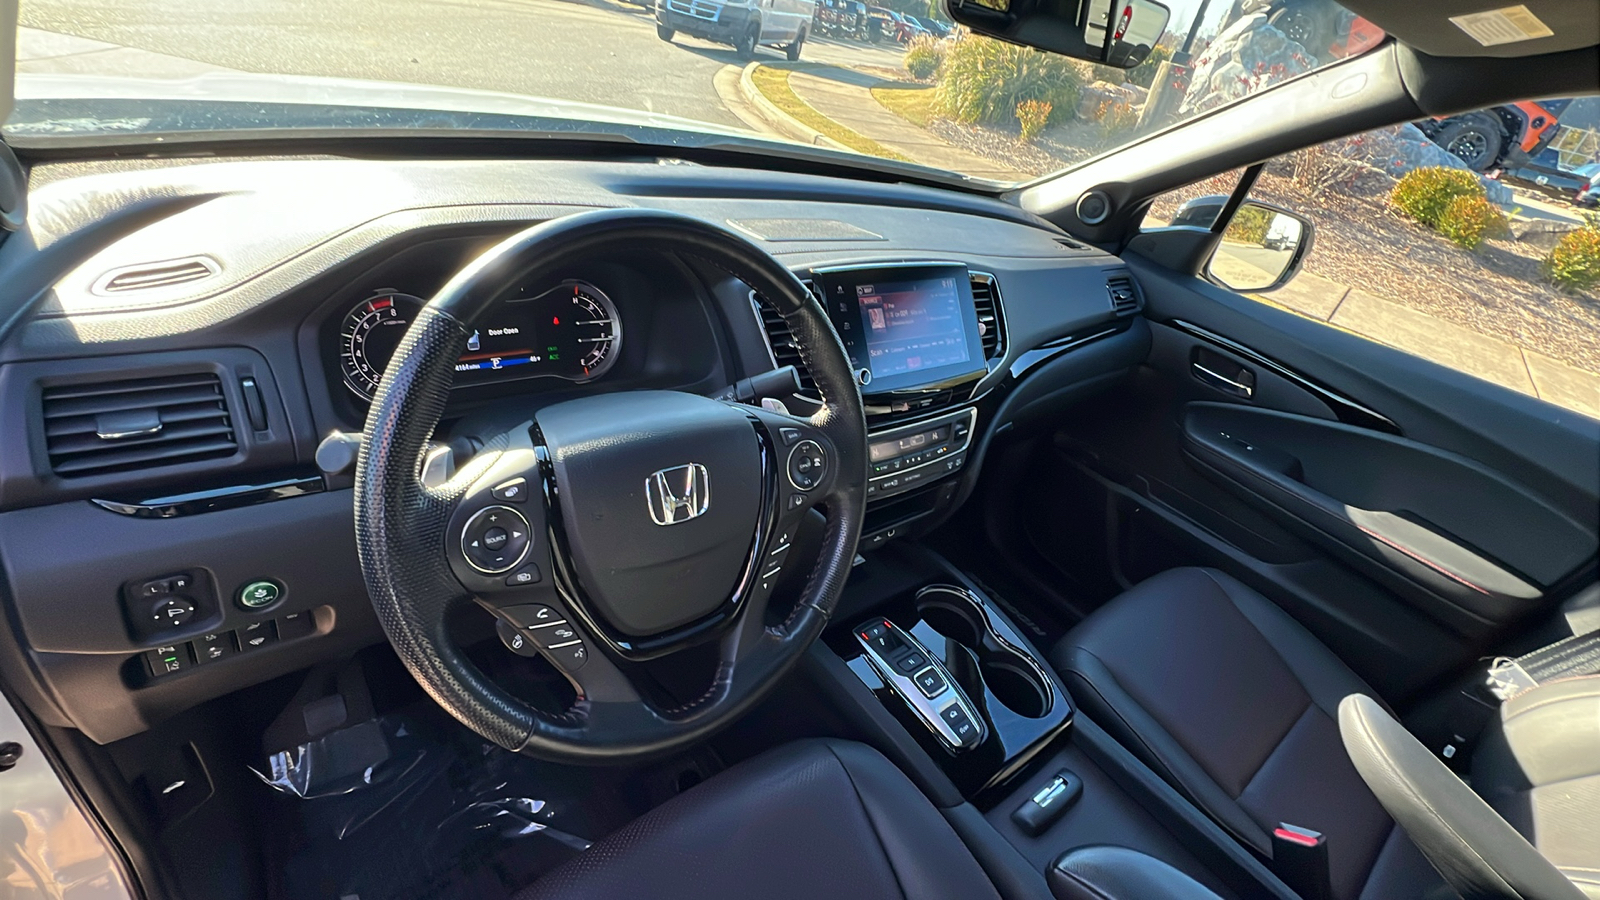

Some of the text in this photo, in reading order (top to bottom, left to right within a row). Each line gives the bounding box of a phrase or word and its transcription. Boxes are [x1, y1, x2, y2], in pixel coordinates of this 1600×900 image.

[375, 312, 381, 321] 7
[390, 308, 397, 317] 8
[362, 321, 370, 330] 6
[503, 327, 519, 335] Open
[355, 334, 363, 343] 5
[355, 350, 362, 358] 4
[870, 348, 883, 357] Scan
[361, 363, 369, 372] 3
[372, 374, 379, 382] 2
[486, 534, 507, 545] SOURCE
